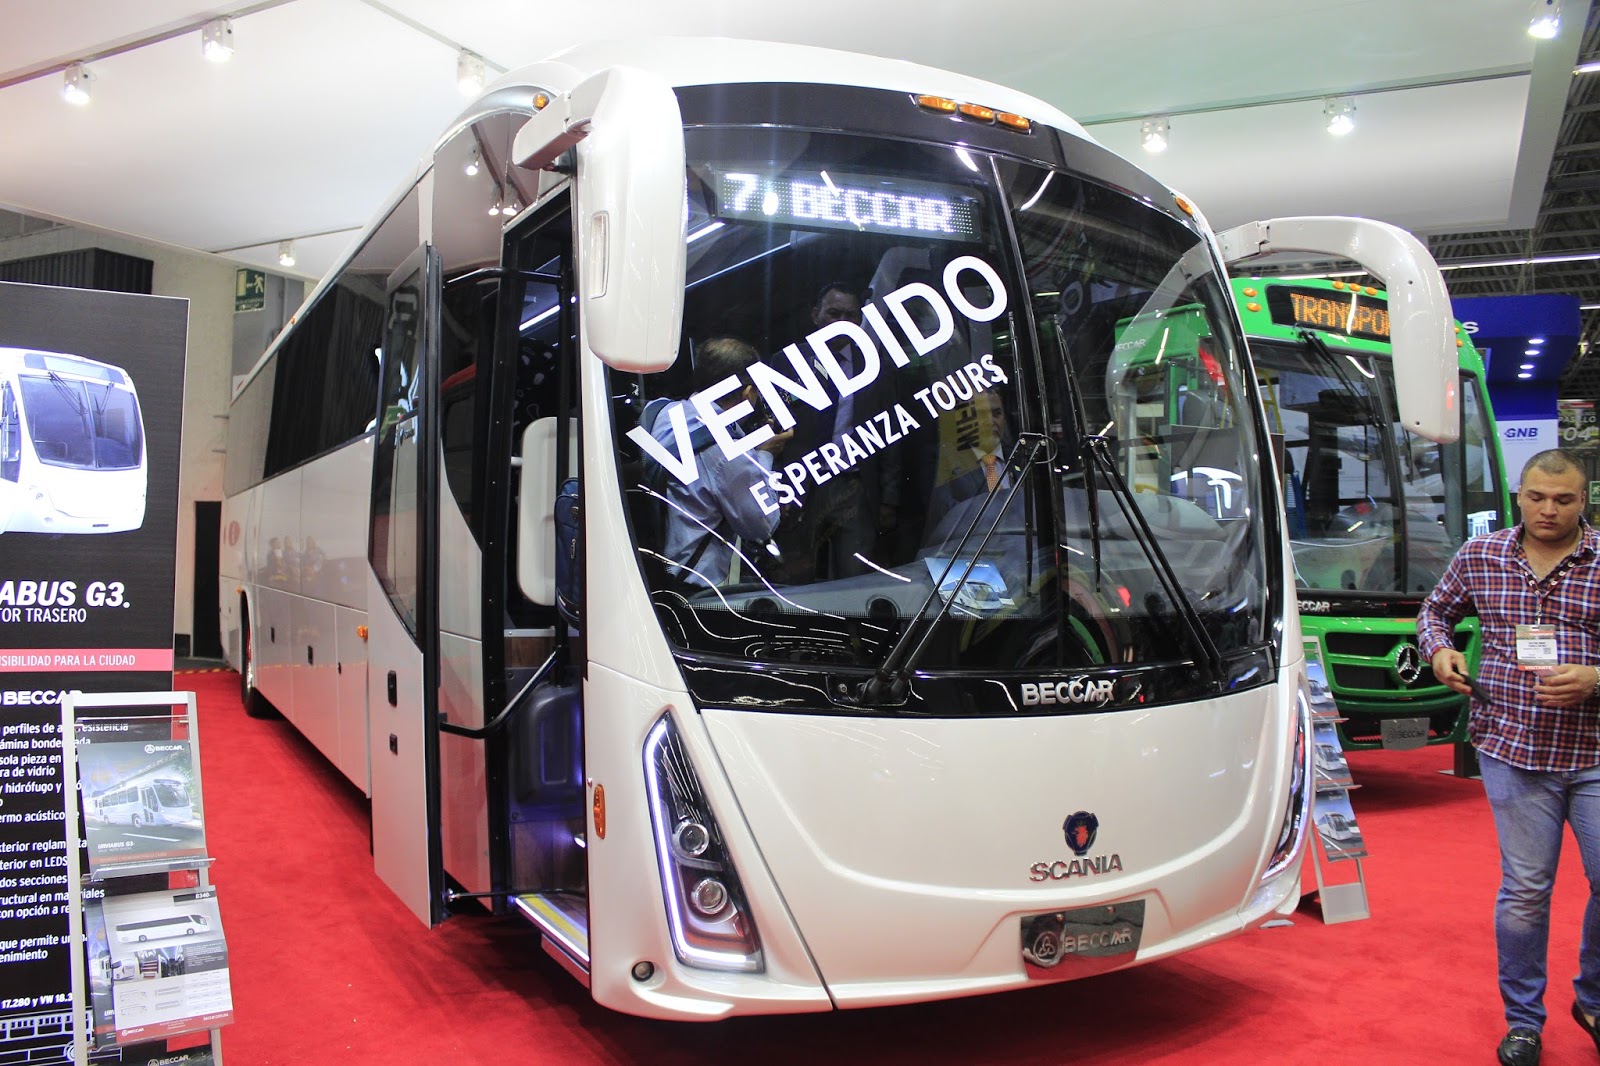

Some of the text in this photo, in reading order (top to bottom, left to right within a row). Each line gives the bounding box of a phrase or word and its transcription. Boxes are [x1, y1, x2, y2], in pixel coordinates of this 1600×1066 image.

[791, 182, 955, 233] BECCAR
[626, 255, 1008, 485] VENDIDO
[1558, 415, 1597, 423] PASLLO
[749, 353, 1004, 516] ESPERANZA TOURS
[1504, 427, 1538, 438] GNB
[0, 580, 130, 608] ABUS G3.
[1298, 600, 1330, 612] ECCAR
[0, 608, 87, 622] OR TRASERO
[54, 655, 80, 666] PARA
[84, 655, 96, 666] LA
[99, 654, 135, 666] CIUDAD
[1021, 680, 1115, 706] BECCAR
[3, 723, 40, 736] perfiles
[43, 722, 54, 734] de
[0, 754, 61, 766] sola pieza en
[12, 767, 24, 777] de
[27, 765, 55, 776] vidrio
[5, 781, 53, 793] hidrófugo
[56, 783, 62, 793] y
[25, 809, 65, 822] acústico
[30, 860, 42, 868] en
[45, 856, 67, 867] LEDS
[1029, 854, 1123, 882] SCANIA
[19, 874, 67, 886] secciones
[40, 893, 52, 902] en
[17, 904, 49, 919] opción
[52, 905, 58, 914] a
[0, 939, 18, 951] que
[20, 935, 59, 950] permite
[1065, 928, 1132, 953] BECCAR
[2, 997, 31, 1009] 17.280
[33, 998, 38, 1008] y
[40, 994, 54, 1005] VW
